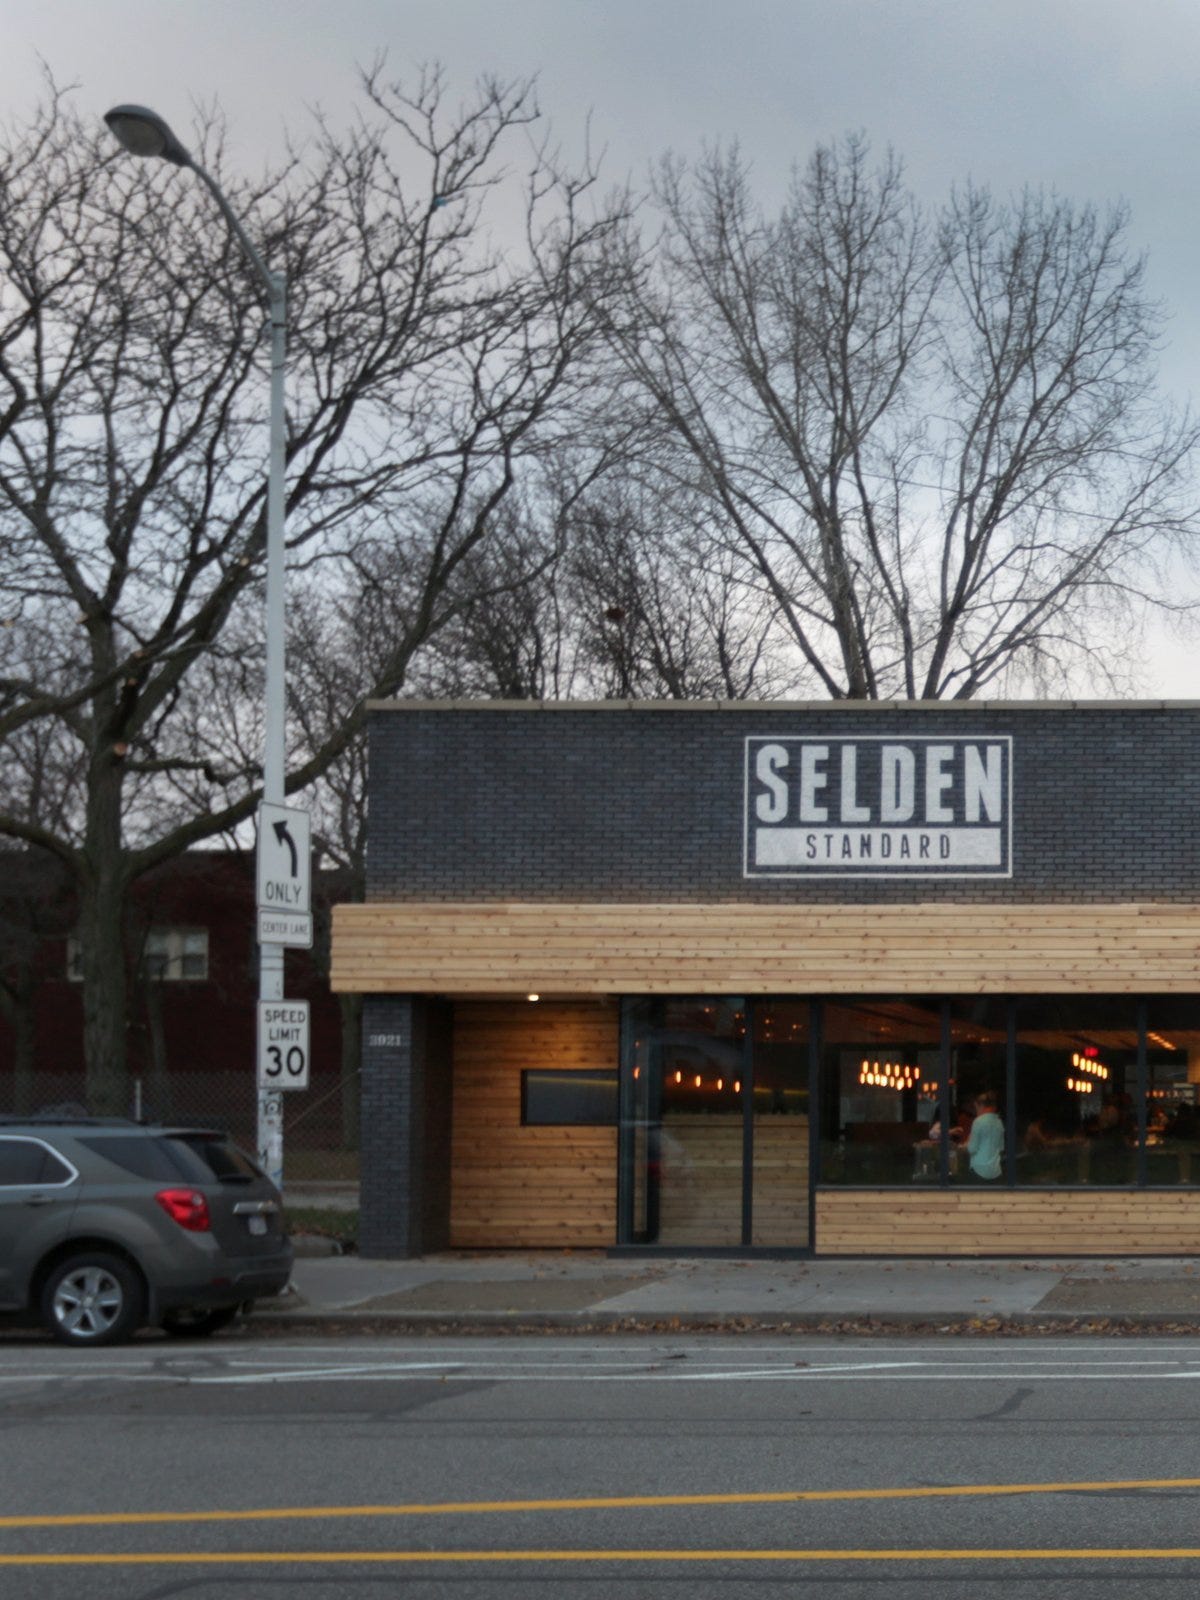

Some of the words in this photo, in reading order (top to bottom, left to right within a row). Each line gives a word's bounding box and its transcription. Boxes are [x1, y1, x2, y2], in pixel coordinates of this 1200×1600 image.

[756, 744, 1001, 823] SELDEN
[806, 833, 951, 859] STANDARD
[265, 881, 302, 903] ONLY
[262, 921, 288, 933] CENTER
[290, 922, 309, 935] LANE
[265, 1009, 306, 1024] SPEED
[268, 1027, 301, 1041] LIMIT
[265, 1045, 305, 1077] 30
